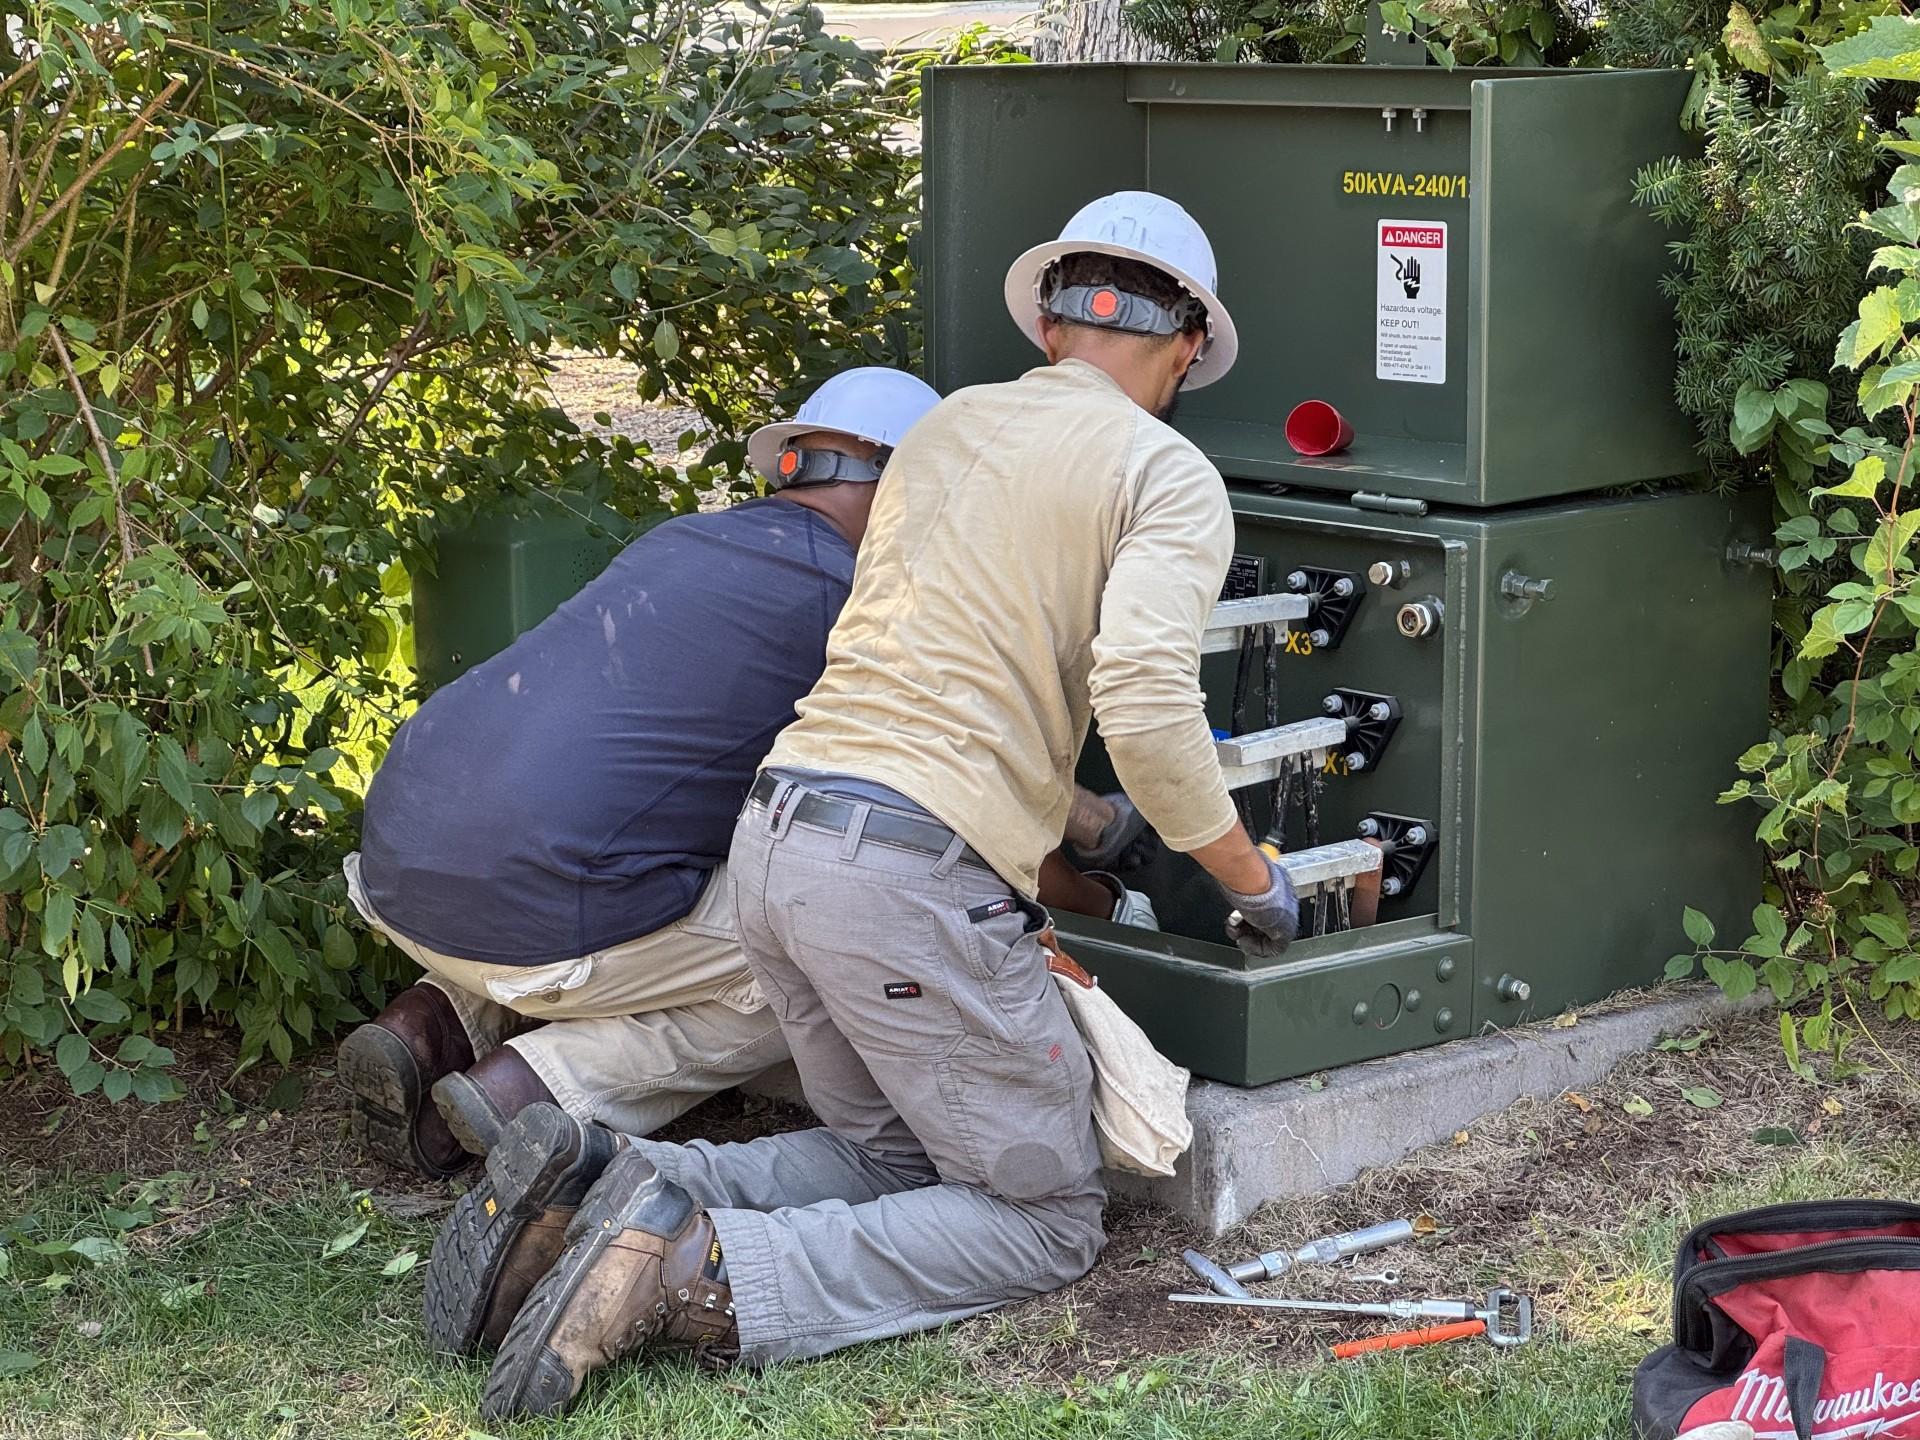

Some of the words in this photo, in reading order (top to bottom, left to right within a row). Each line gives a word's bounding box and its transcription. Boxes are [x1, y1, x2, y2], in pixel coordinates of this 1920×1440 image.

[1343, 171, 1471, 199] 50kVA-240/1
[1395, 231, 1441, 245] DANGER
[1380, 304, 1416, 313] Hazardous
[1417, 307, 1444, 316] voltage.
[1381, 319, 1400, 327] KEEP
[1402, 320, 1420, 328] OUT!
[1285, 630, 1313, 656] X3
[1322, 752, 1348, 776] X1
